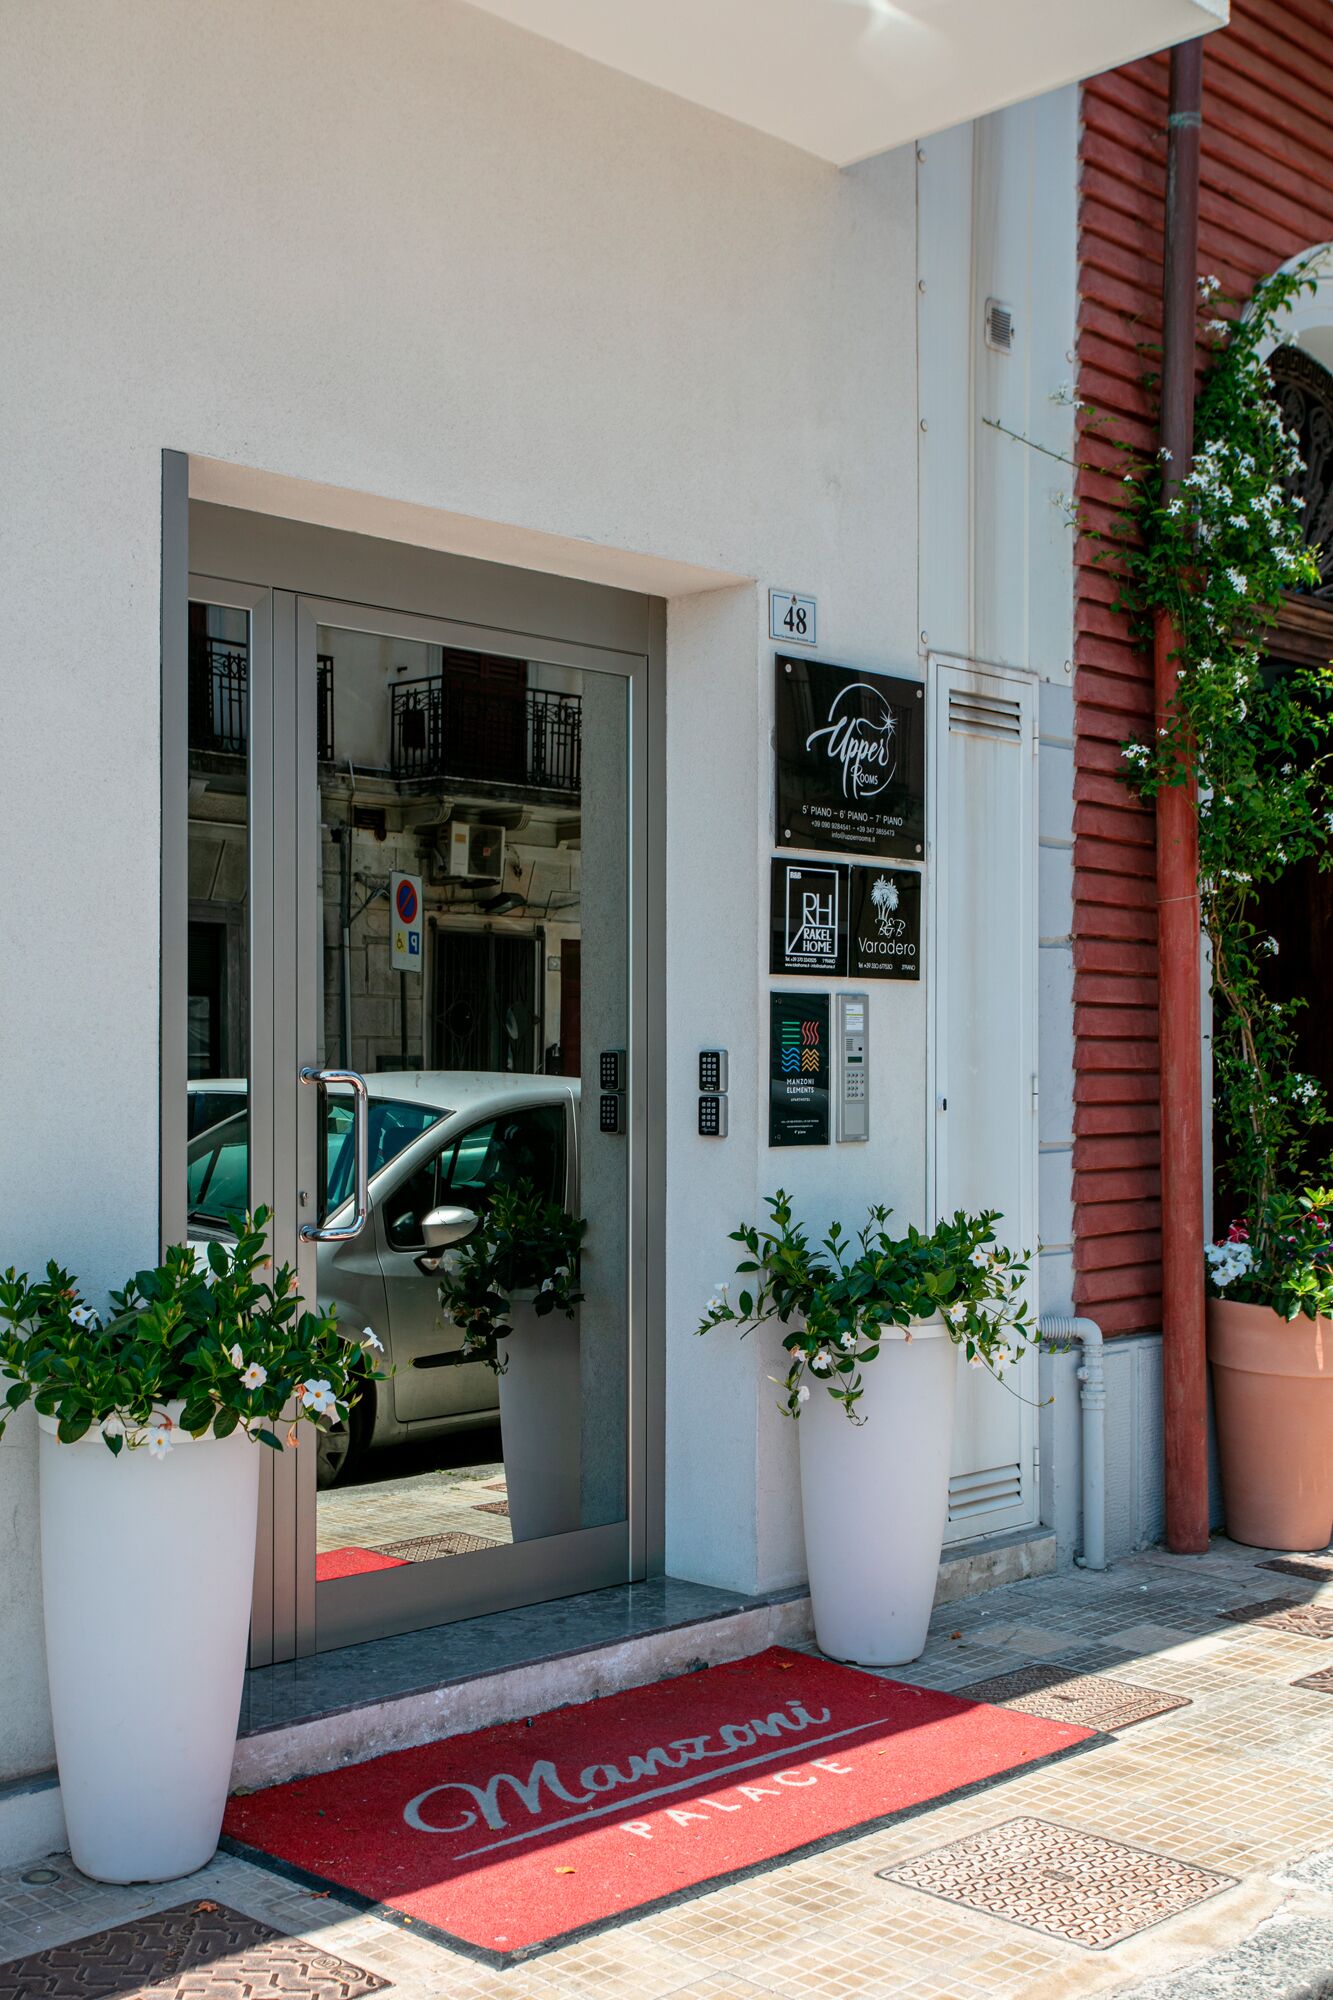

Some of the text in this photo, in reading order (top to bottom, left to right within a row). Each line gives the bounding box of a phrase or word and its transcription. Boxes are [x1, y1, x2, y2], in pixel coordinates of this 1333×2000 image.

[783, 605, 807, 635] 48
[806, 716, 890, 800] Upper
[810, 806, 832, 818] PIANO
[847, 811, 868, 822] PIANO
[883, 815, 903, 827] PIANO
[811, 820, 820, 828] +39
[821, 821, 830, 829] 090
[856, 825, 865, 833] +39
[866, 826, 875, 834] 347
[803, 892, 833, 926] RH
[803, 928, 832, 941] RAKEL
[875, 918, 906, 939] B&B
[803, 941, 832, 953] HOME
[858, 937, 916, 956] Varadero
[403, 1699, 832, 1835] Manzoni
[620, 1756, 854, 1840] PALACE
